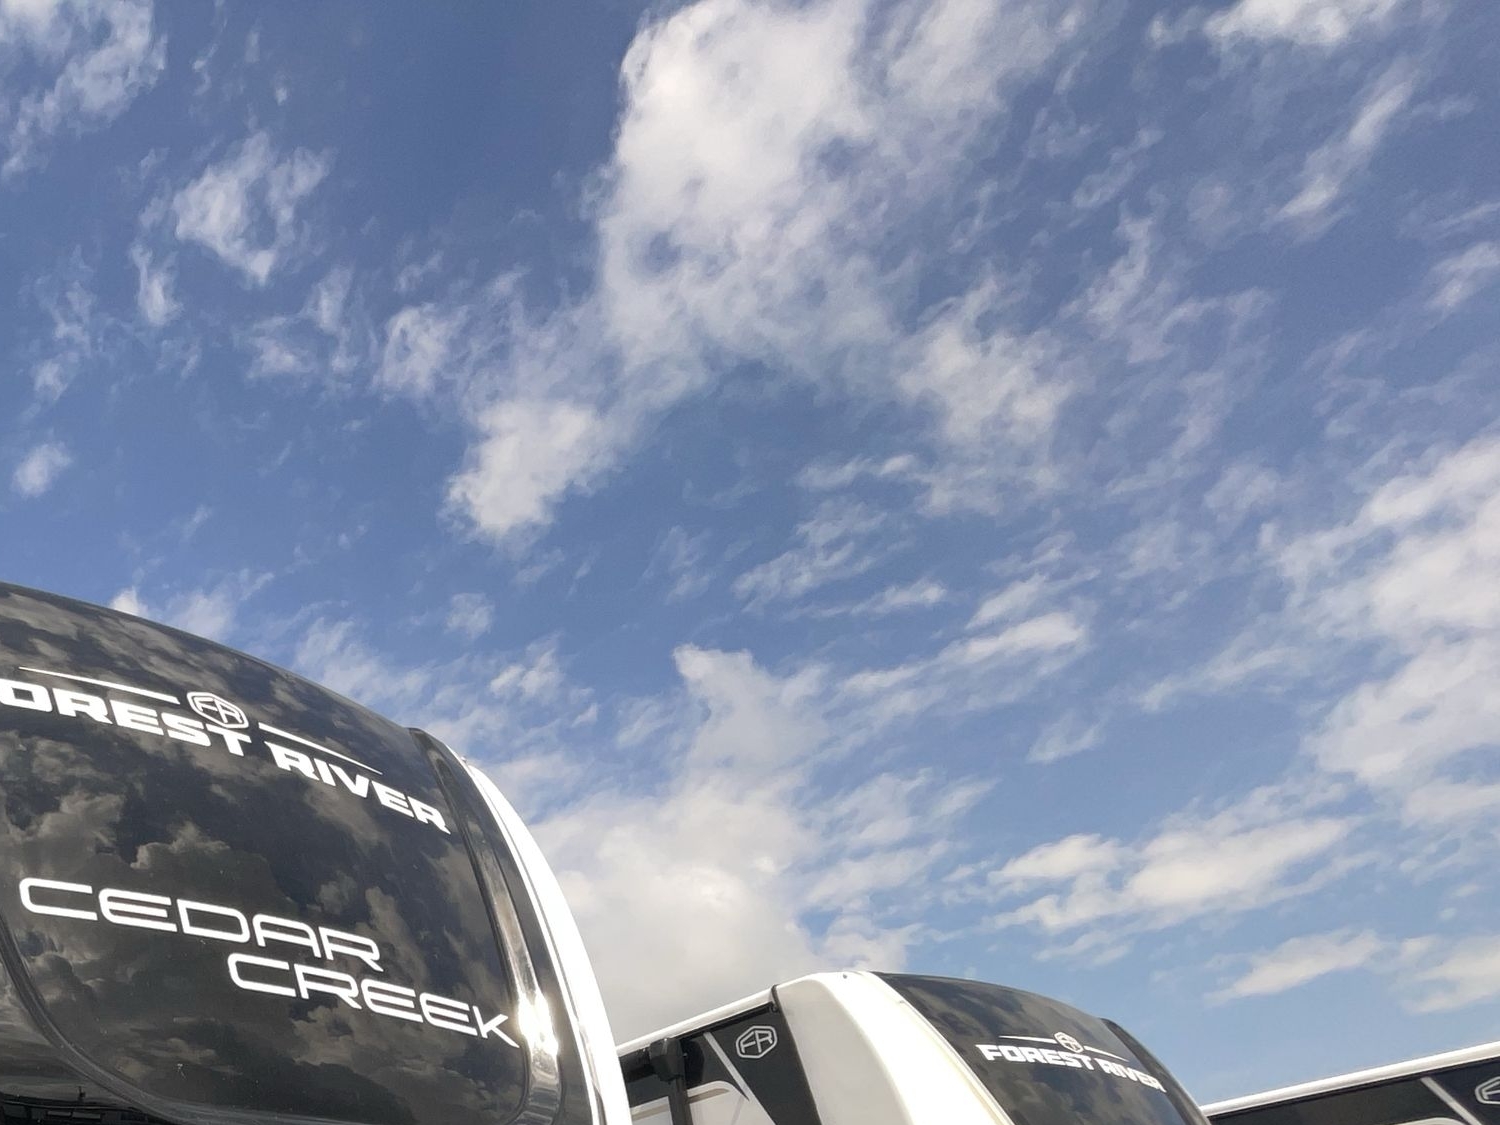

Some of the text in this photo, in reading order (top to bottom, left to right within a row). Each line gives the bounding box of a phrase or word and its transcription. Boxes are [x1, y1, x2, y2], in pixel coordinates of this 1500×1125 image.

[264, 740, 451, 834] RIVER
[19, 877, 384, 972] CEDAR
[227, 953, 520, 1048] CREEK
[975, 1044, 1168, 1093] FOREST RIVER
